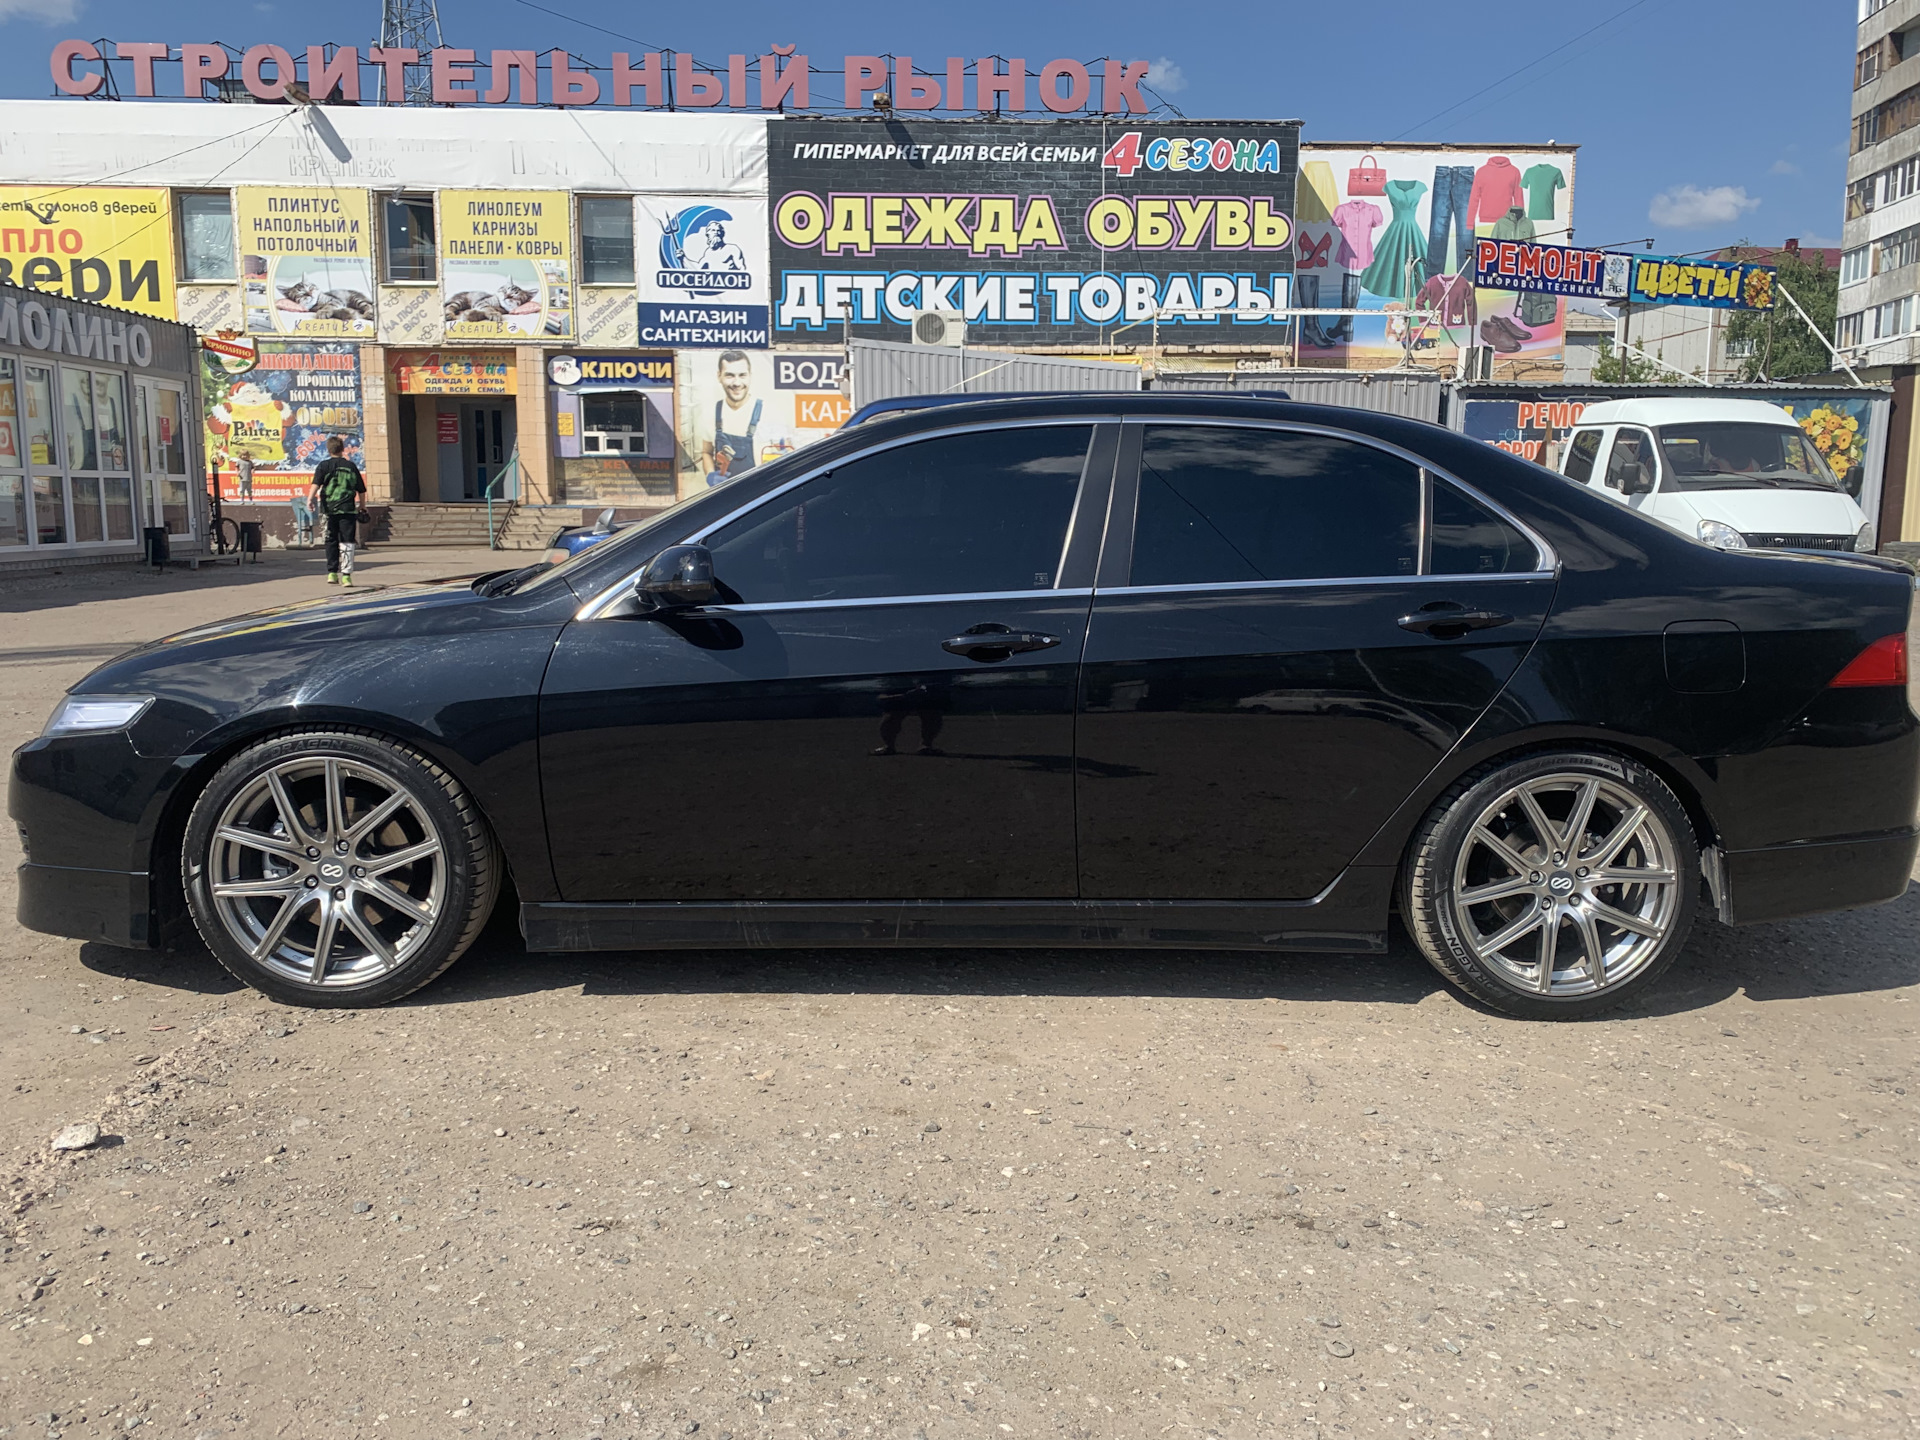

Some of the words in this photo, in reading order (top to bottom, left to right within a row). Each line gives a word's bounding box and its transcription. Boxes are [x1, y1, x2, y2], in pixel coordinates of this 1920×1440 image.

[51, 39, 809, 109] СТРОИТЕЛЬНЫЙ
[844, 55, 1150, 114] РЫНОК
[793, 142, 932, 161] ГИПЕРМАРКЕТ
[932, 144, 974, 164] ДЛЯ
[974, 142, 1028, 162] ВСЕЙ
[1031, 146, 1097, 163] СЕМЬИ
[1101, 132, 1144, 177] 4
[1146, 137, 1281, 173] СЕЗОНА
[38, 201, 98, 213] салонов
[103, 202, 157, 215] дверей
[268, 197, 340, 213] ПЛИНТУС
[467, 201, 542, 216] ЛИНОЛЕУМ
[253, 216, 346, 233] НАПОЛЬНЫЙ
[350, 219, 360, 233] И
[472, 221, 538, 236] КАРНИЗЫ
[773, 190, 1069, 258] ОДЕЖДА
[1084, 193, 1293, 252] ОБУВЬ
[257, 235, 357, 252] ПОТОЛОЧНЫЙ
[450, 240, 504, 255] ПАНЕЛИ
[516, 241, 563, 255] КОВРЫ
[1478, 240, 1603, 284] РЕМОНТ
[658, 271, 751, 288] ПОСЕЙДОН
[1478, 275, 1543, 290] ЦИФРОВОЙ
[1547, 282, 1601, 295] ТЕХНИКИ
[1636, 262, 1742, 299] ЦВЕТЫ
[776, 270, 1040, 331] ДЕТСКИЕ
[1042, 271, 1293, 326] ТОВАРЫ
[202, 302, 231, 333] ВЫБОР
[383, 317, 399, 335] НА
[397, 289, 432, 320] ЛЮБОЙ
[581, 292, 637, 343] ПОСТУПЛЕНИЯ
[587, 296, 617, 325] НОВЫЕ
[660, 309, 748, 325] МАГАЗИН
[402, 309, 428, 333] ВКУС
[641, 327, 766, 344] САНТЕХНИКИ
[205, 340, 252, 358] ЕРМОЛИНО
[255, 353, 354, 372] ИКВИДАЦИЯ
[421, 352, 441, 375] 4
[442, 361, 508, 375] СЕЗОНА
[581, 360, 673, 379] КЛЮЧИ
[1236, 358, 1281, 370] Ceresit
[296, 375, 355, 388] ПРОШЛЫХ
[779, 361, 845, 388] ВОД
[289, 388, 356, 403] КОЛЛЕКЦИЙ
[449, 385, 470, 393] ВСЕЙ
[296, 407, 358, 427] ОБОЕВ
[1517, 402, 1588, 429] РЕМО
[233, 420, 280, 437] Palitra
[603, 460, 631, 470] KEY
[639, 460, 670, 470] MAN
[252, 475, 309, 485] ТРОИТЕЛЬНЫЙ
[1447, 937, 1496, 991] DRAGON
